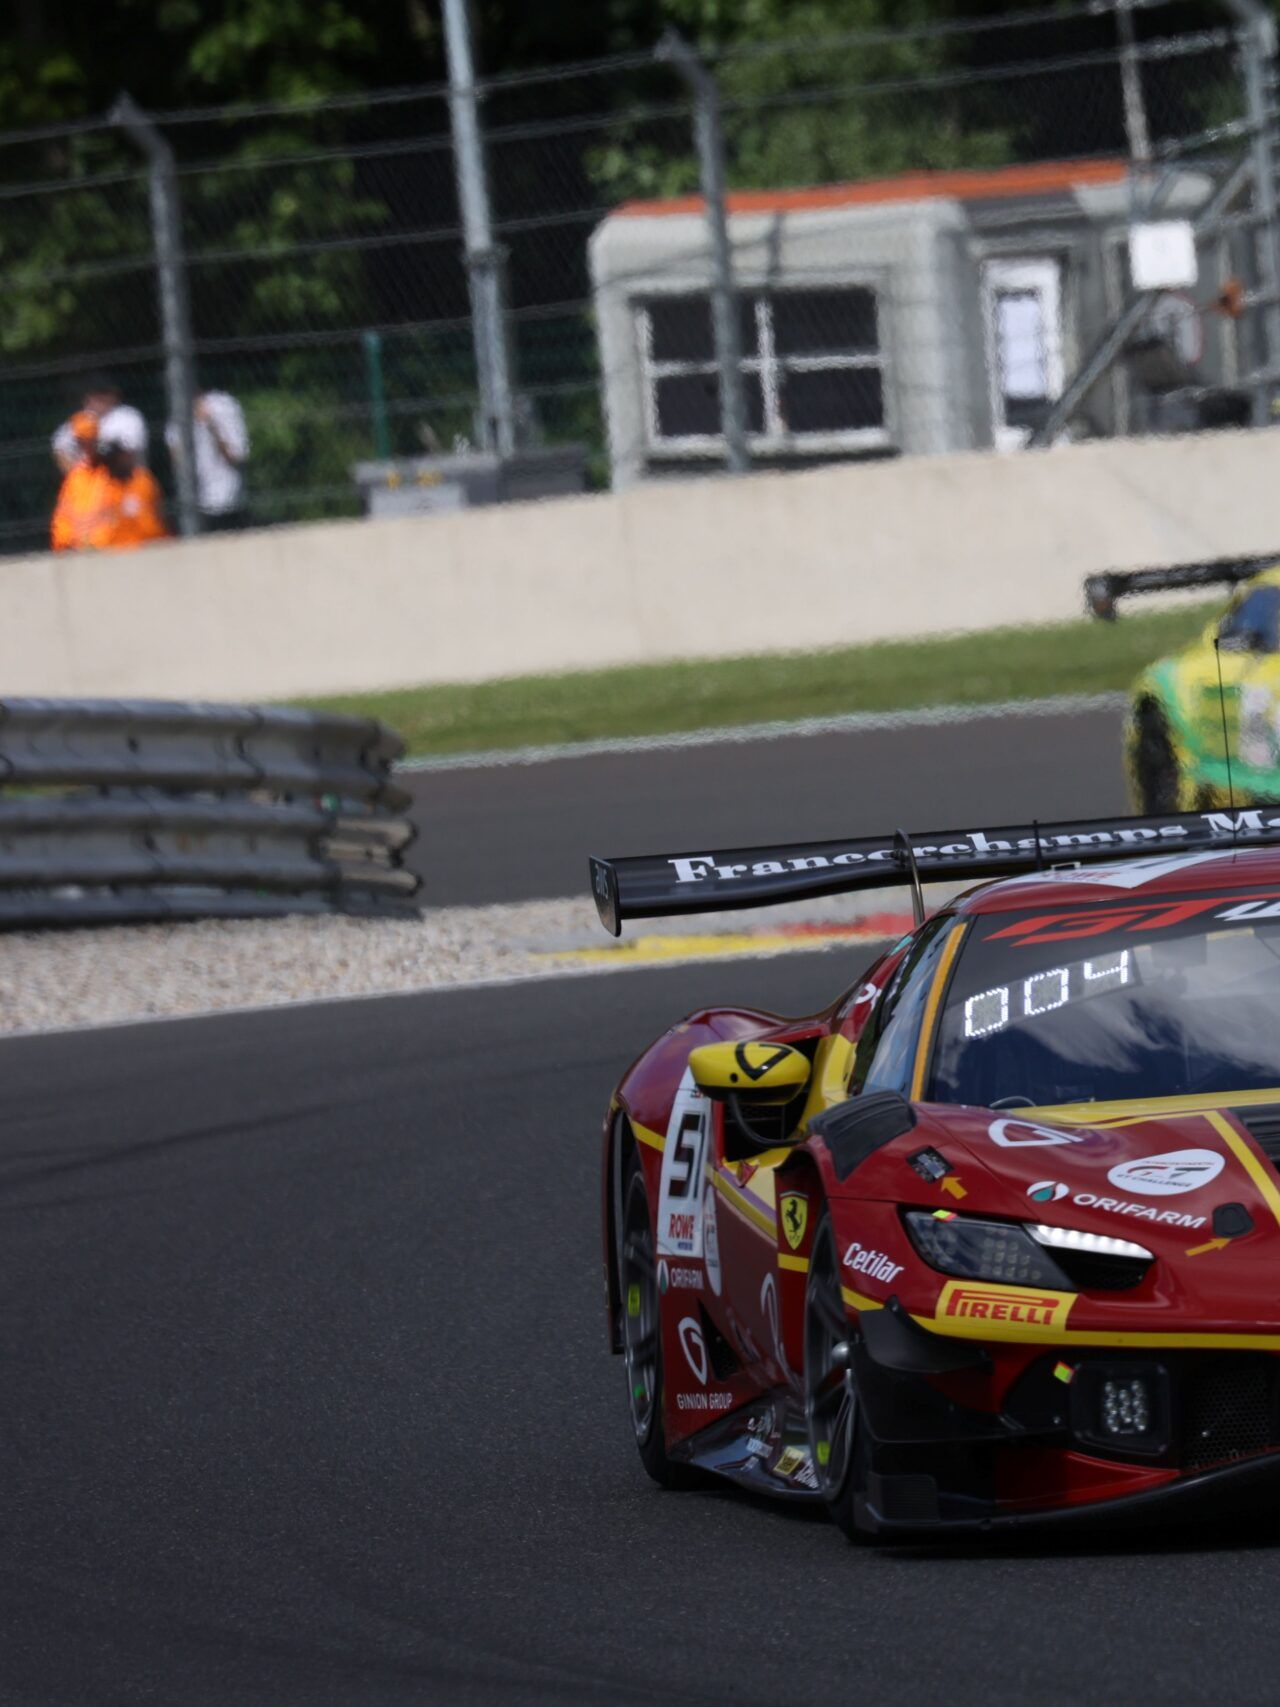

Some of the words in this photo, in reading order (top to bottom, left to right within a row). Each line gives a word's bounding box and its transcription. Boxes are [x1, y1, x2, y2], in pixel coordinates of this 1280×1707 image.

[668, 1213, 695, 1240] ROWE
[1073, 1193, 1207, 1229] ORIFARM
[843, 1242, 905, 1283] Cetilar
[946, 1288, 1060, 1325] PIRELLI
[677, 1392, 708, 1410] GINION
[709, 1392, 733, 1410] GROUP
